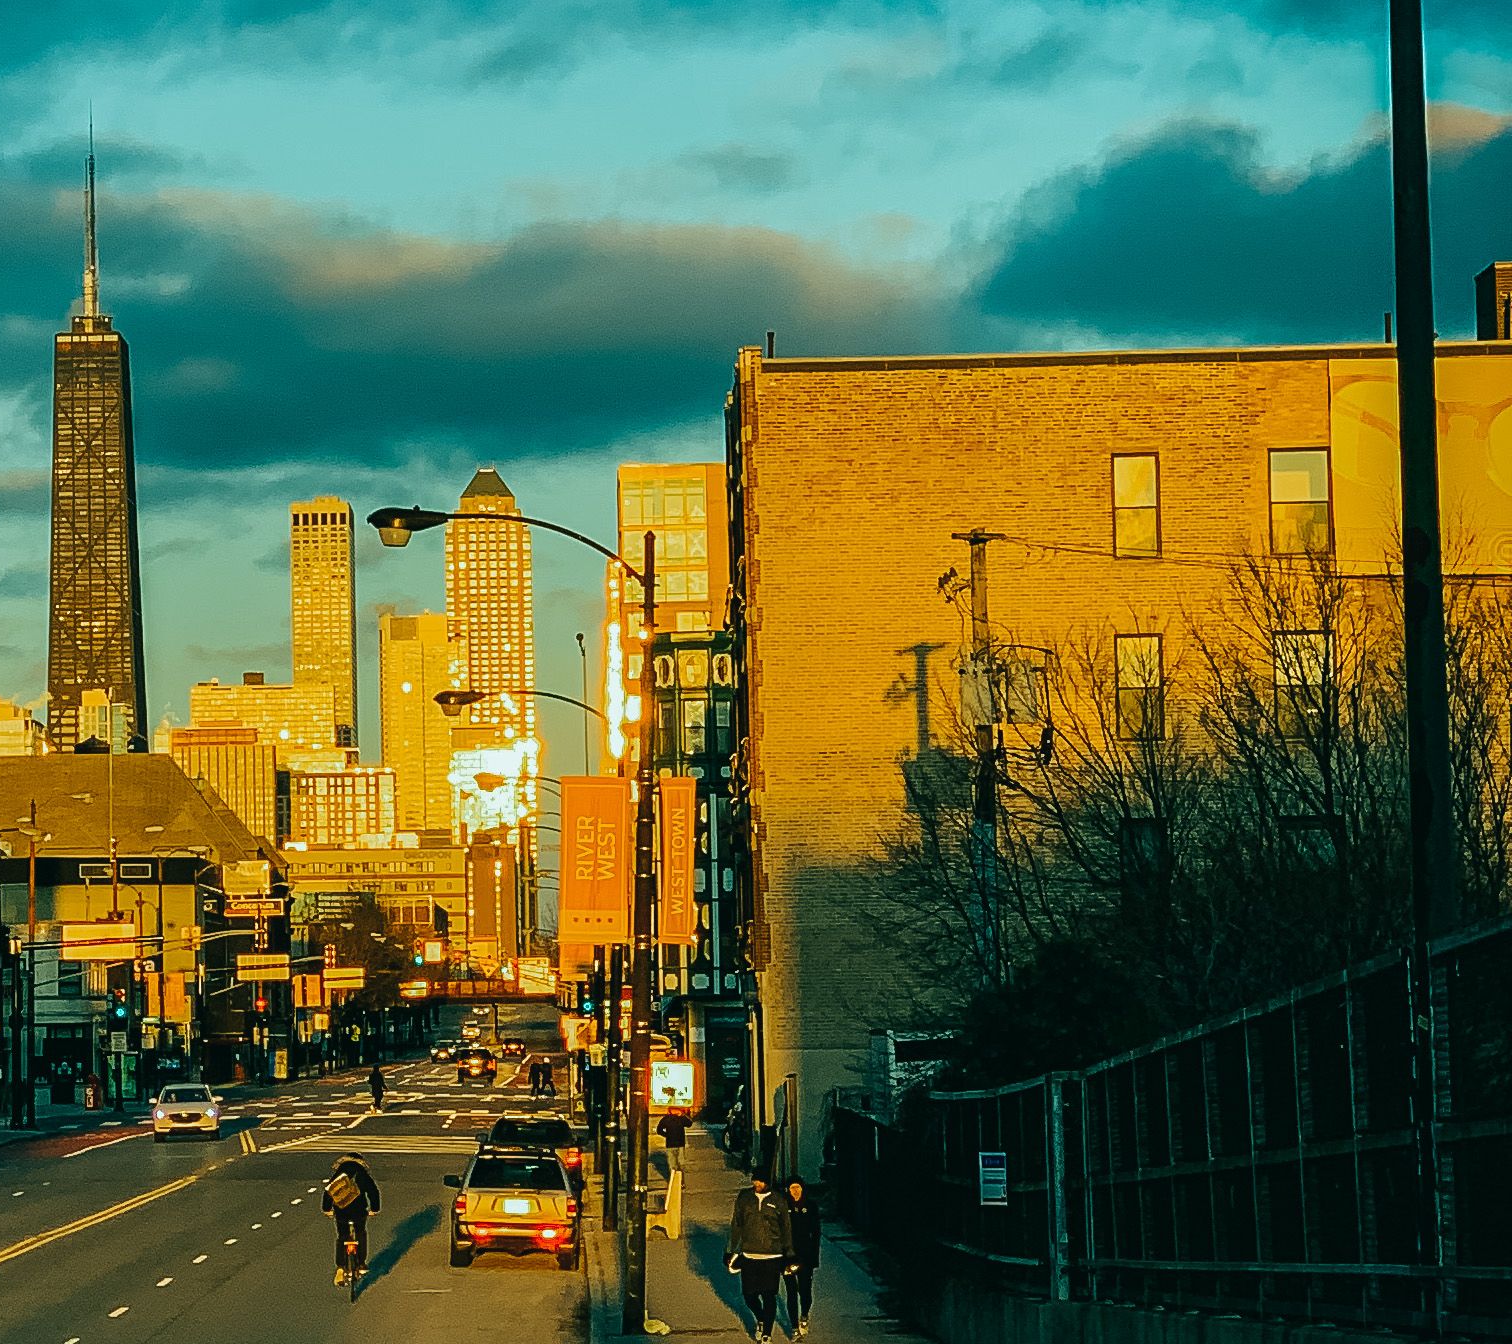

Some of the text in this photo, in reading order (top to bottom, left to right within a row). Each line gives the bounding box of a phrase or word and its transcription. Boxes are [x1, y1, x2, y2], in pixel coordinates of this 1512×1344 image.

[575, 815, 595, 881] RIVER
[597, 818, 616, 881] WEST
[671, 807, 686, 915] WEST TOWN
